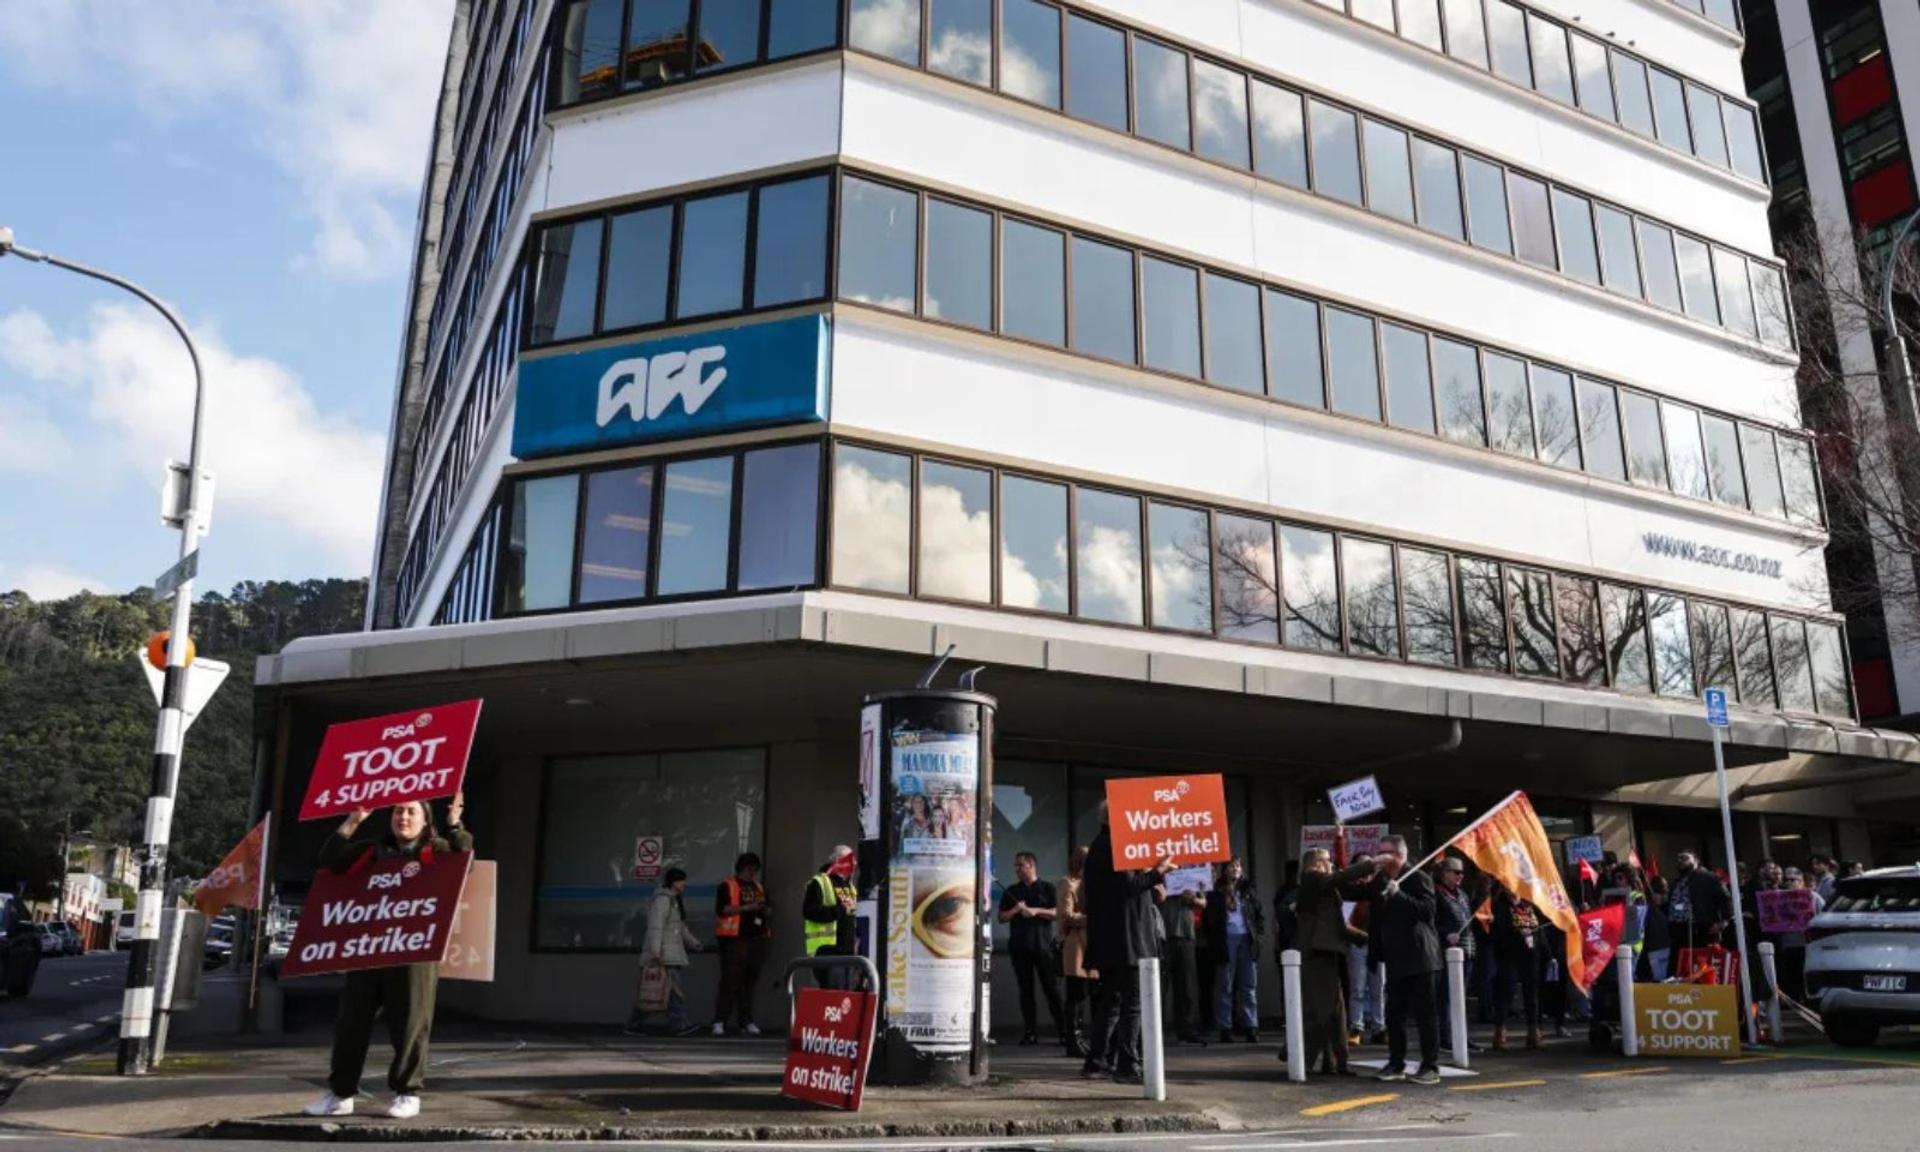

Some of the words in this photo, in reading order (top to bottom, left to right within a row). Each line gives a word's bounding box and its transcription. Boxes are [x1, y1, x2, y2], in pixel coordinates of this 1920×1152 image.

[382, 724, 415, 740] PSA
[343, 736, 447, 778] TOOT
[315, 789, 331, 807] 4
[334, 768, 454, 805] SUPPORT
[1153, 788, 1181, 802] PSA
[1124, 807, 1213, 832] Workers
[1124, 842, 1151, 860] on
[1155, 831, 1219, 857] strike!
[366, 873, 402, 890] PSA
[321, 895, 437, 928] Workers
[301, 941, 337, 963] on
[341, 923, 437, 957] strike!
[1668, 993, 1693, 1005] PSA
[824, 1005, 842, 1022] PSA
[1645, 1009, 1719, 1031] TOOT
[802, 1026, 858, 1059] Workers
[1651, 1035, 1732, 1050] SUPPORT
[791, 1066, 809, 1086] on
[810, 1065, 857, 1095] strike!
